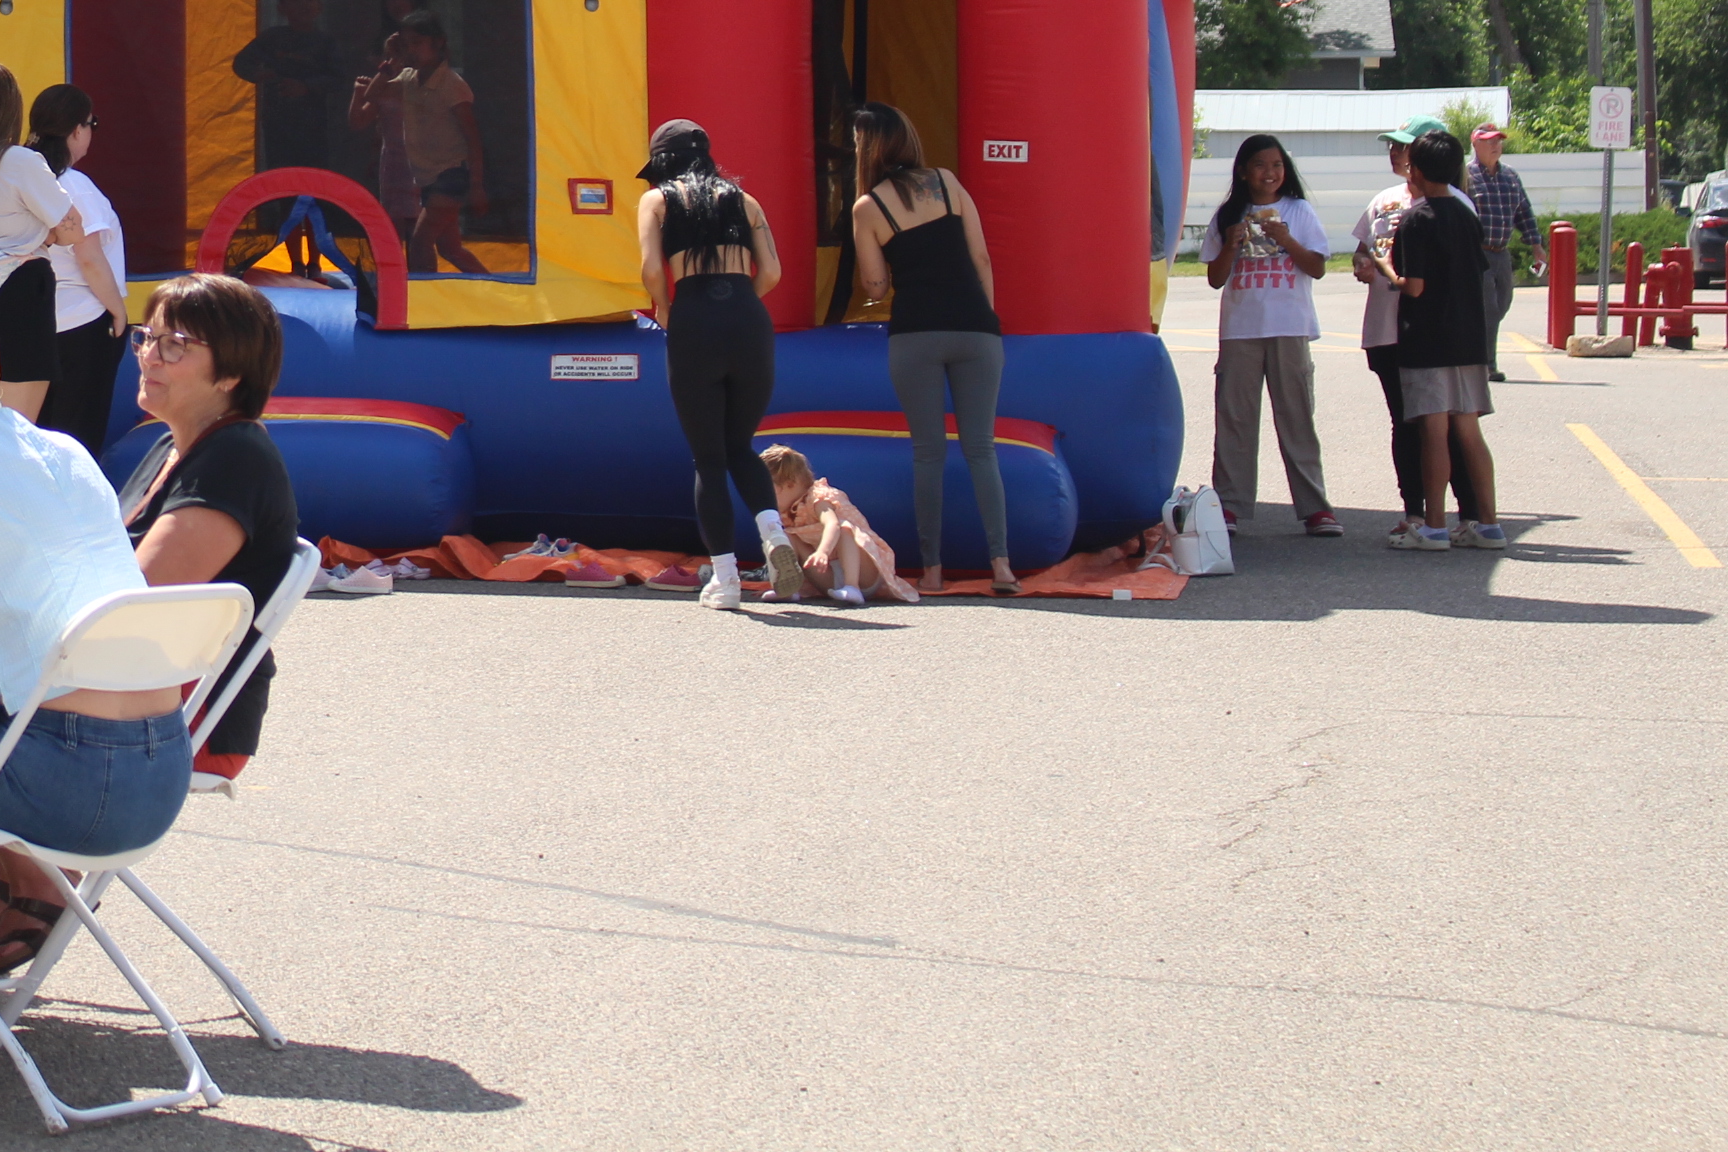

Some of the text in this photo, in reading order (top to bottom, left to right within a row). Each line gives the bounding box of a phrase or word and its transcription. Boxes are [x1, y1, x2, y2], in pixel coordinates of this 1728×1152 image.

[1598, 121, 1624, 131] FIRE
[988, 144, 1023, 158] EXIT
[1232, 273, 1296, 290] KITTY
